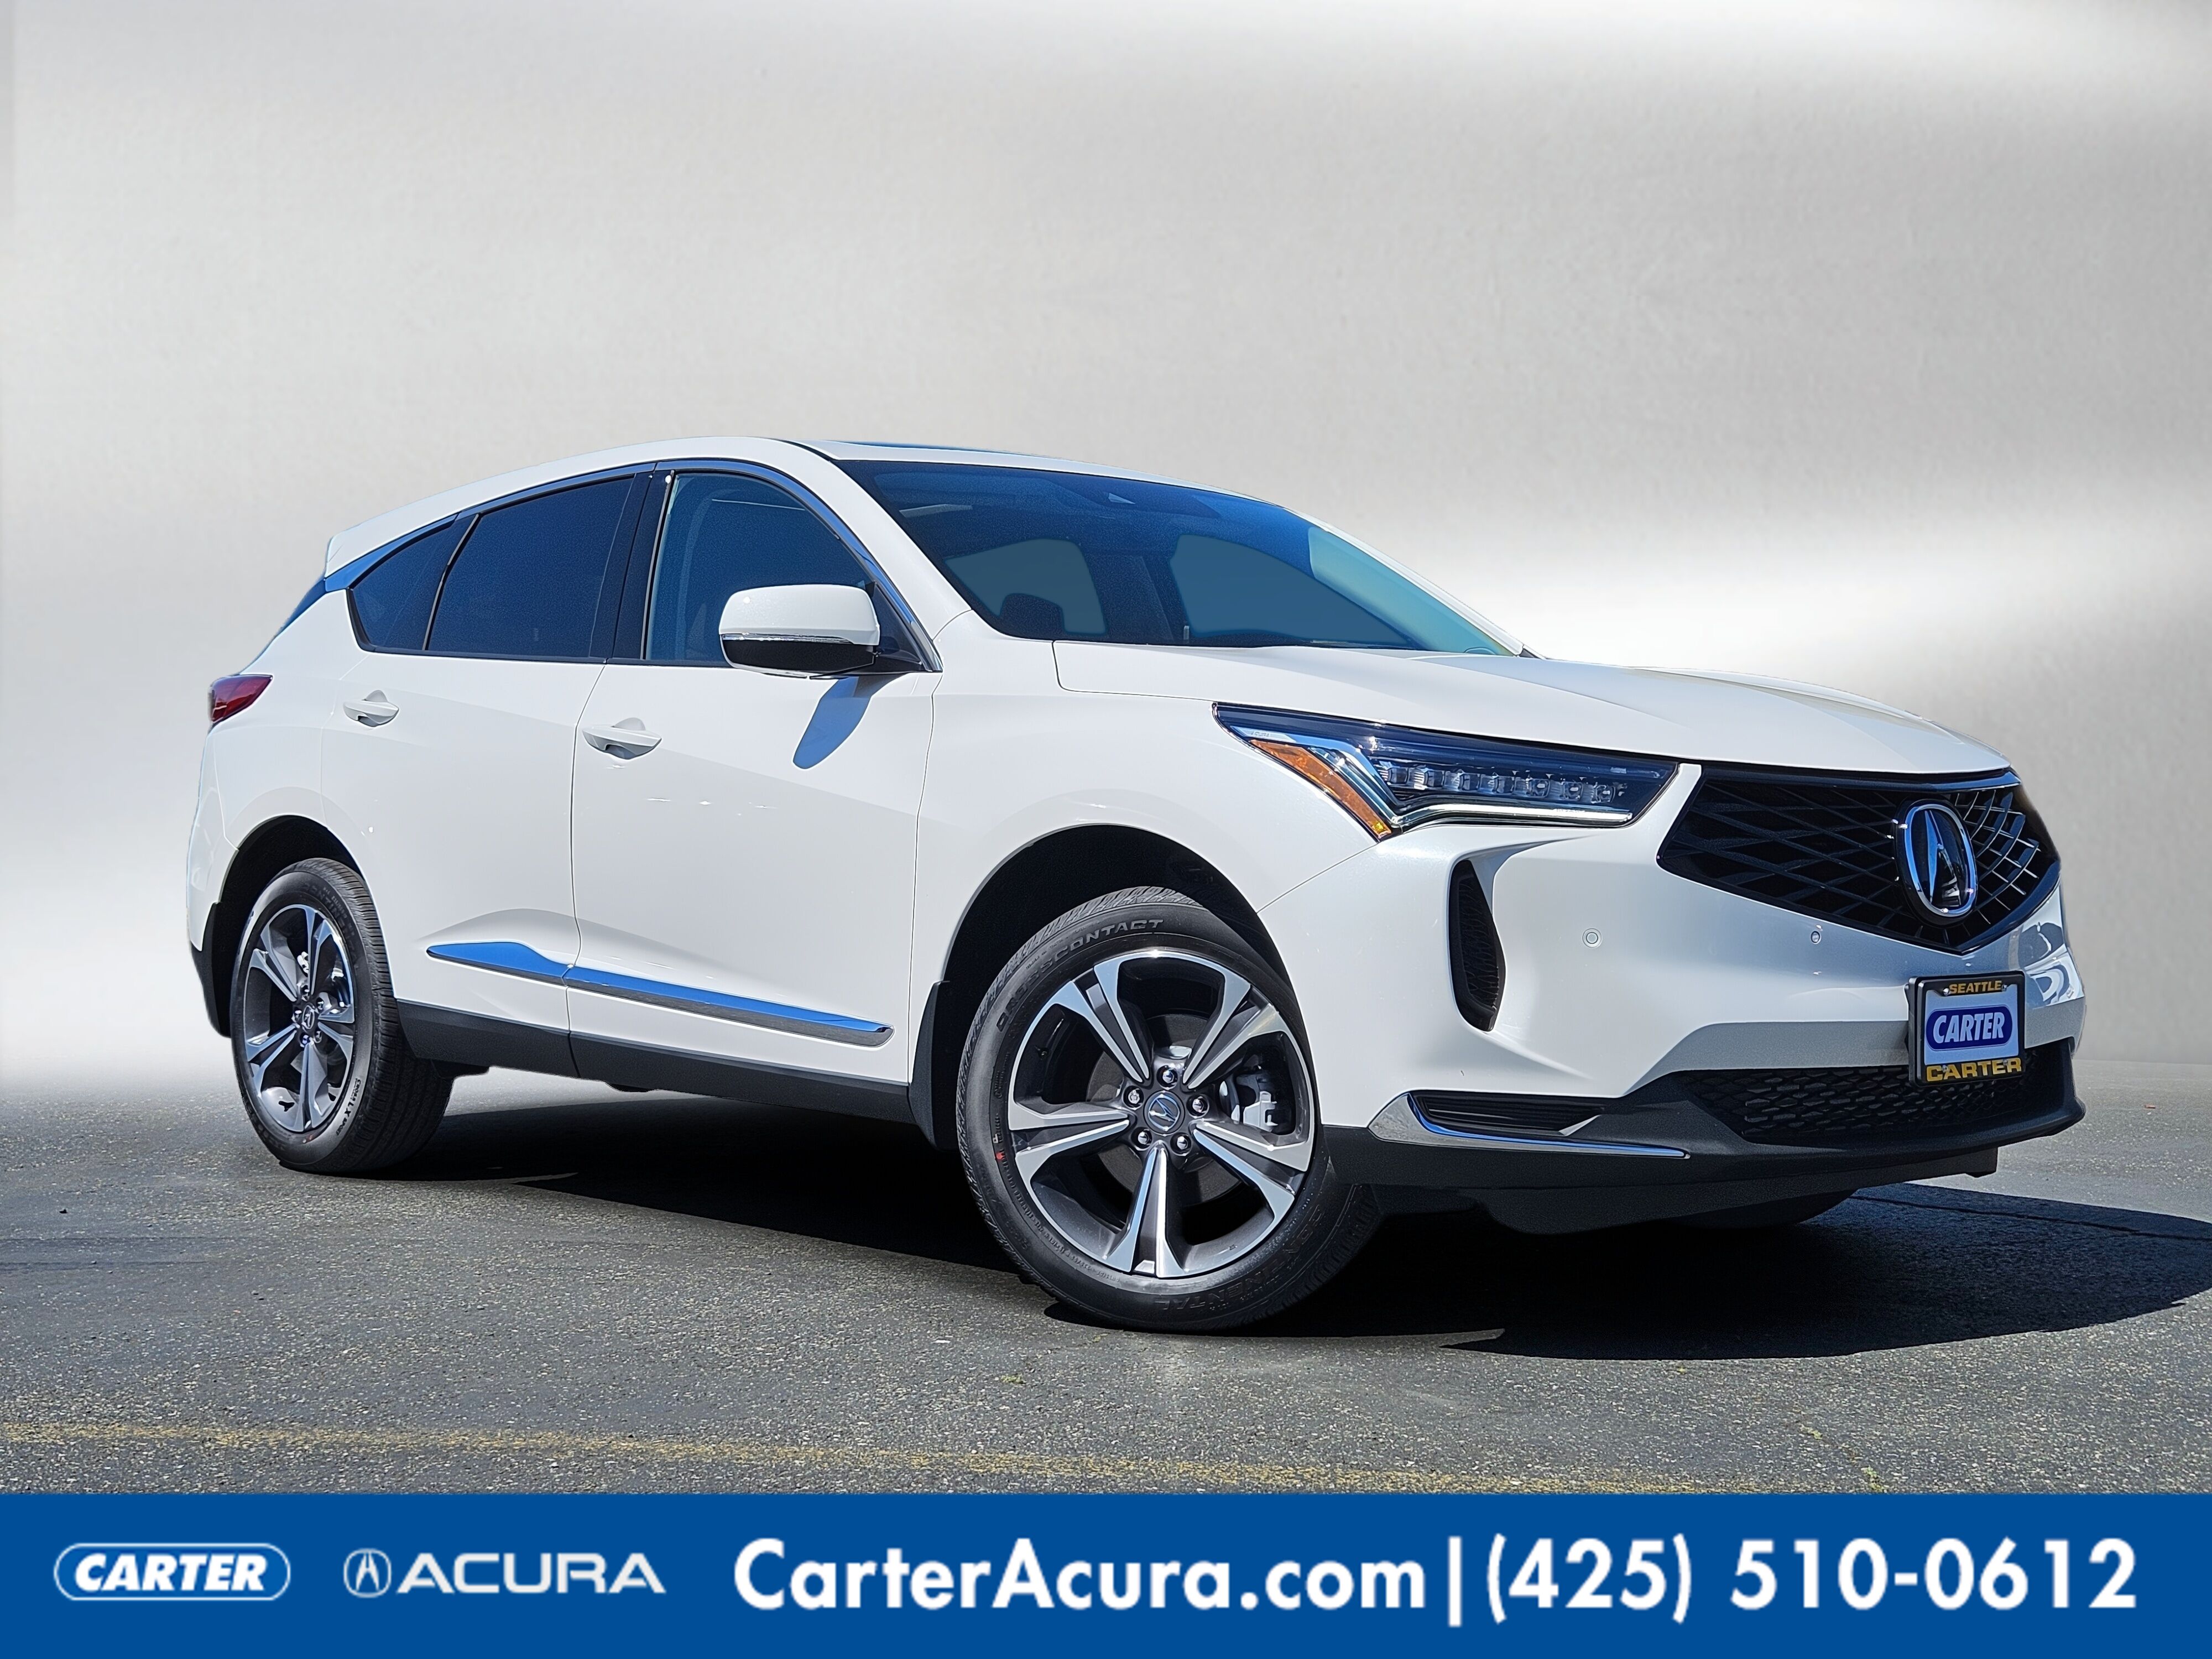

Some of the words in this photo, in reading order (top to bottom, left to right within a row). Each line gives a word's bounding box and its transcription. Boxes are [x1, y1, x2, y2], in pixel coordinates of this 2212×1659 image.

[1948, 980, 2002, 994] SEATTLE
[1933, 1011, 2005, 1044] CARTER
[1926, 1057, 2022, 1082] CARTER
